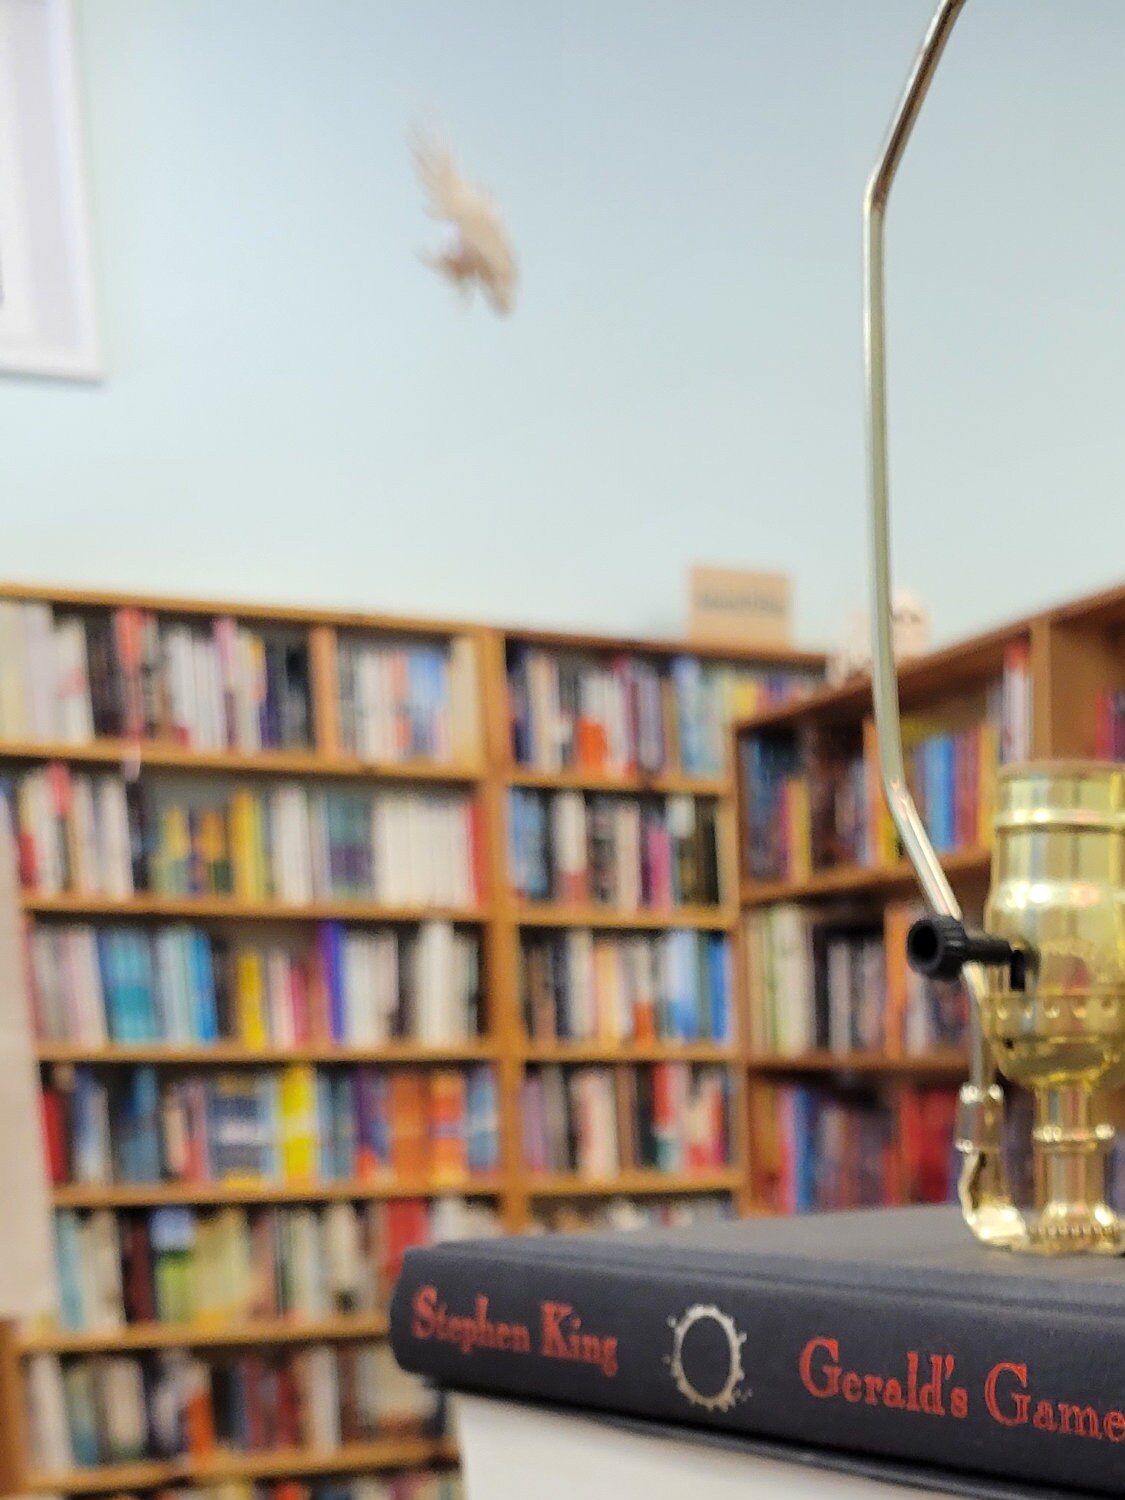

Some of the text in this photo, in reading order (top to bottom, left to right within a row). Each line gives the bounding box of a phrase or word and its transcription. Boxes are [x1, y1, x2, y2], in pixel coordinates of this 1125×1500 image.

[410, 1284, 619, 1378] Stephen King
[798, 1335, 970, 1419] Gerald's
